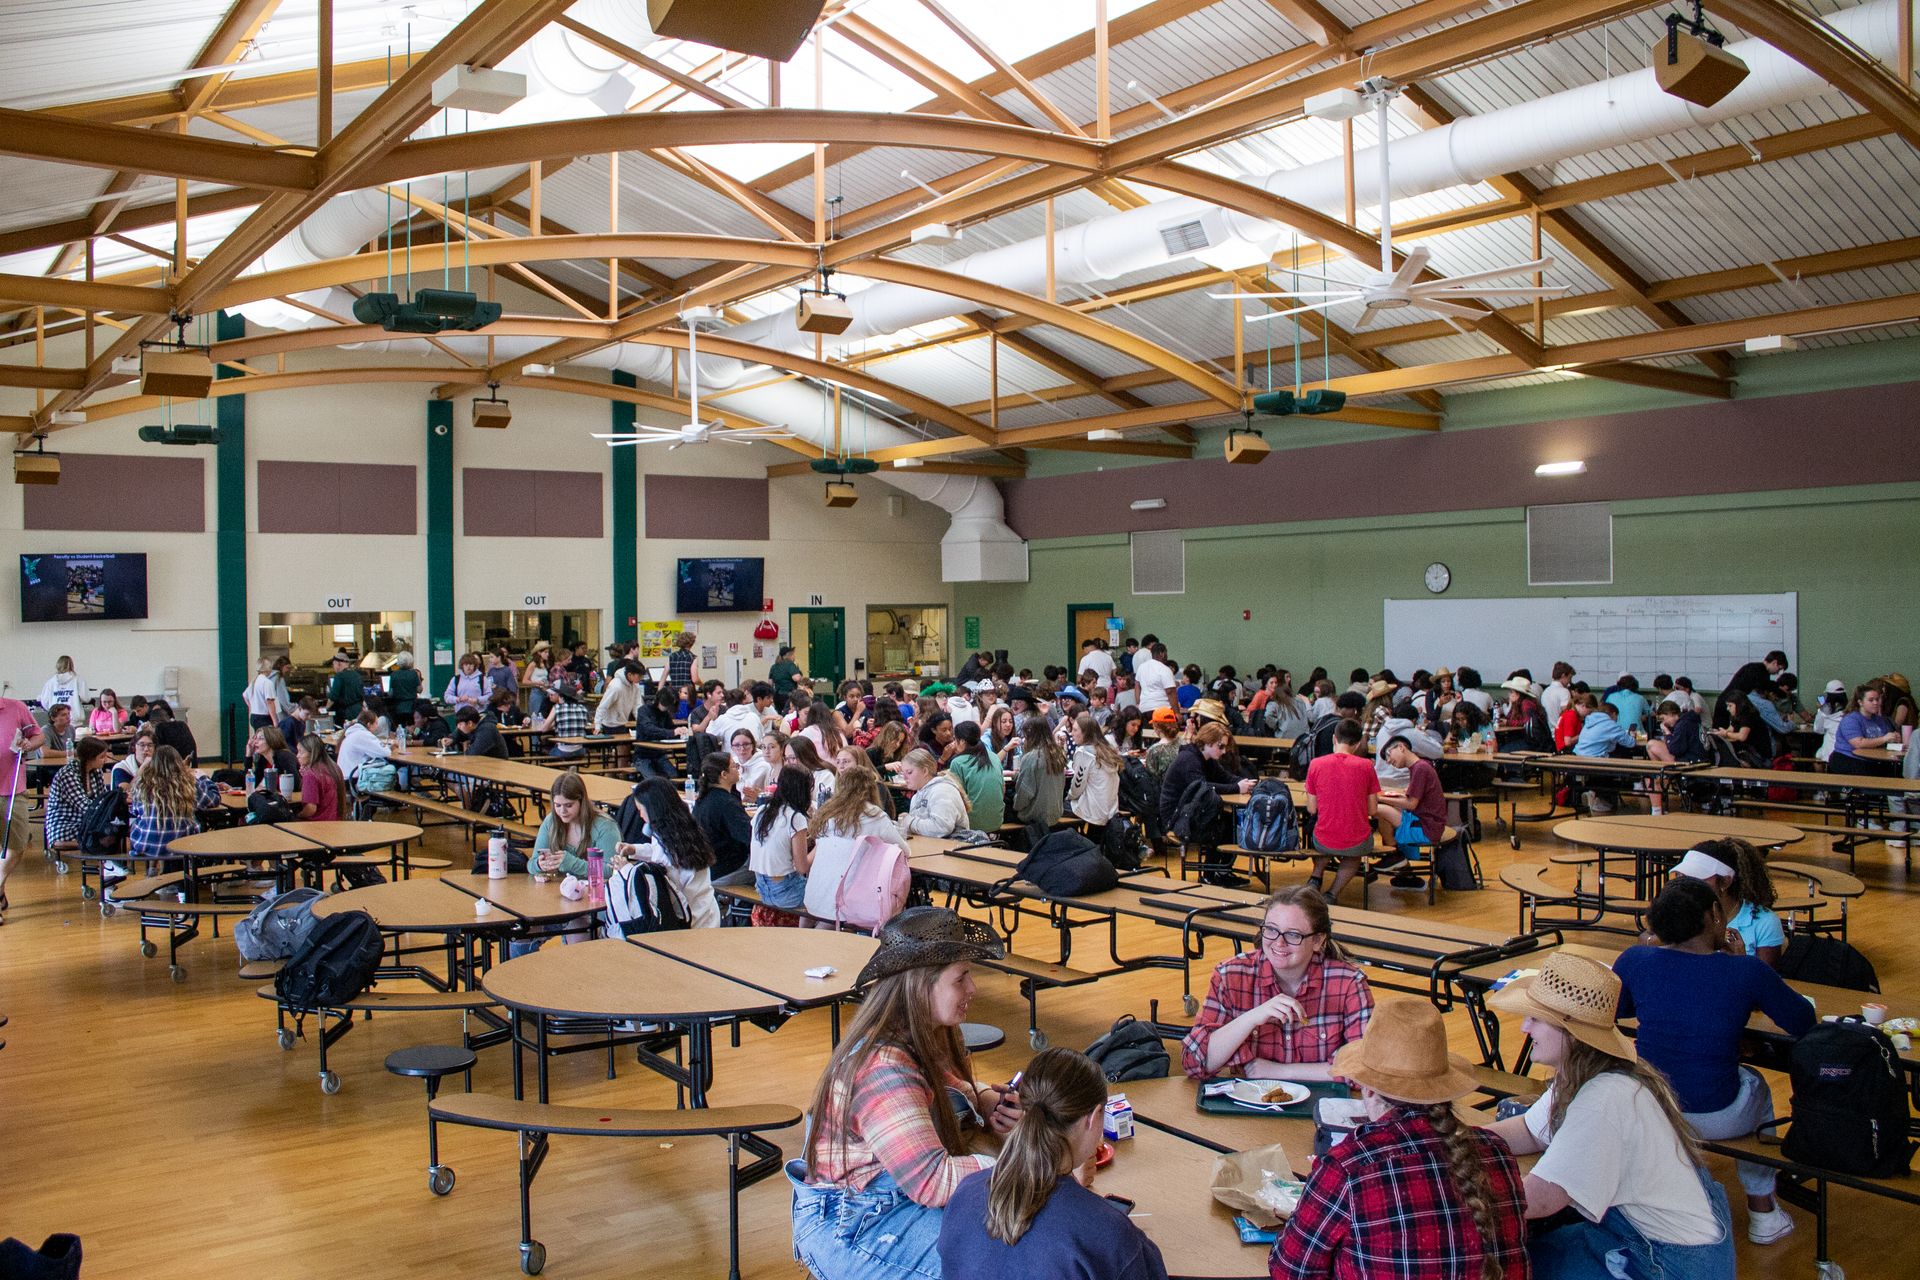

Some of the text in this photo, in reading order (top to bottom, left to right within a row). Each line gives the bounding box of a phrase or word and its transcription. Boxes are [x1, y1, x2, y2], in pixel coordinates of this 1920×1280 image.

[327, 598, 351, 608] OUT
[525, 596, 546, 605] OUT
[811, 595, 822, 605] IN
